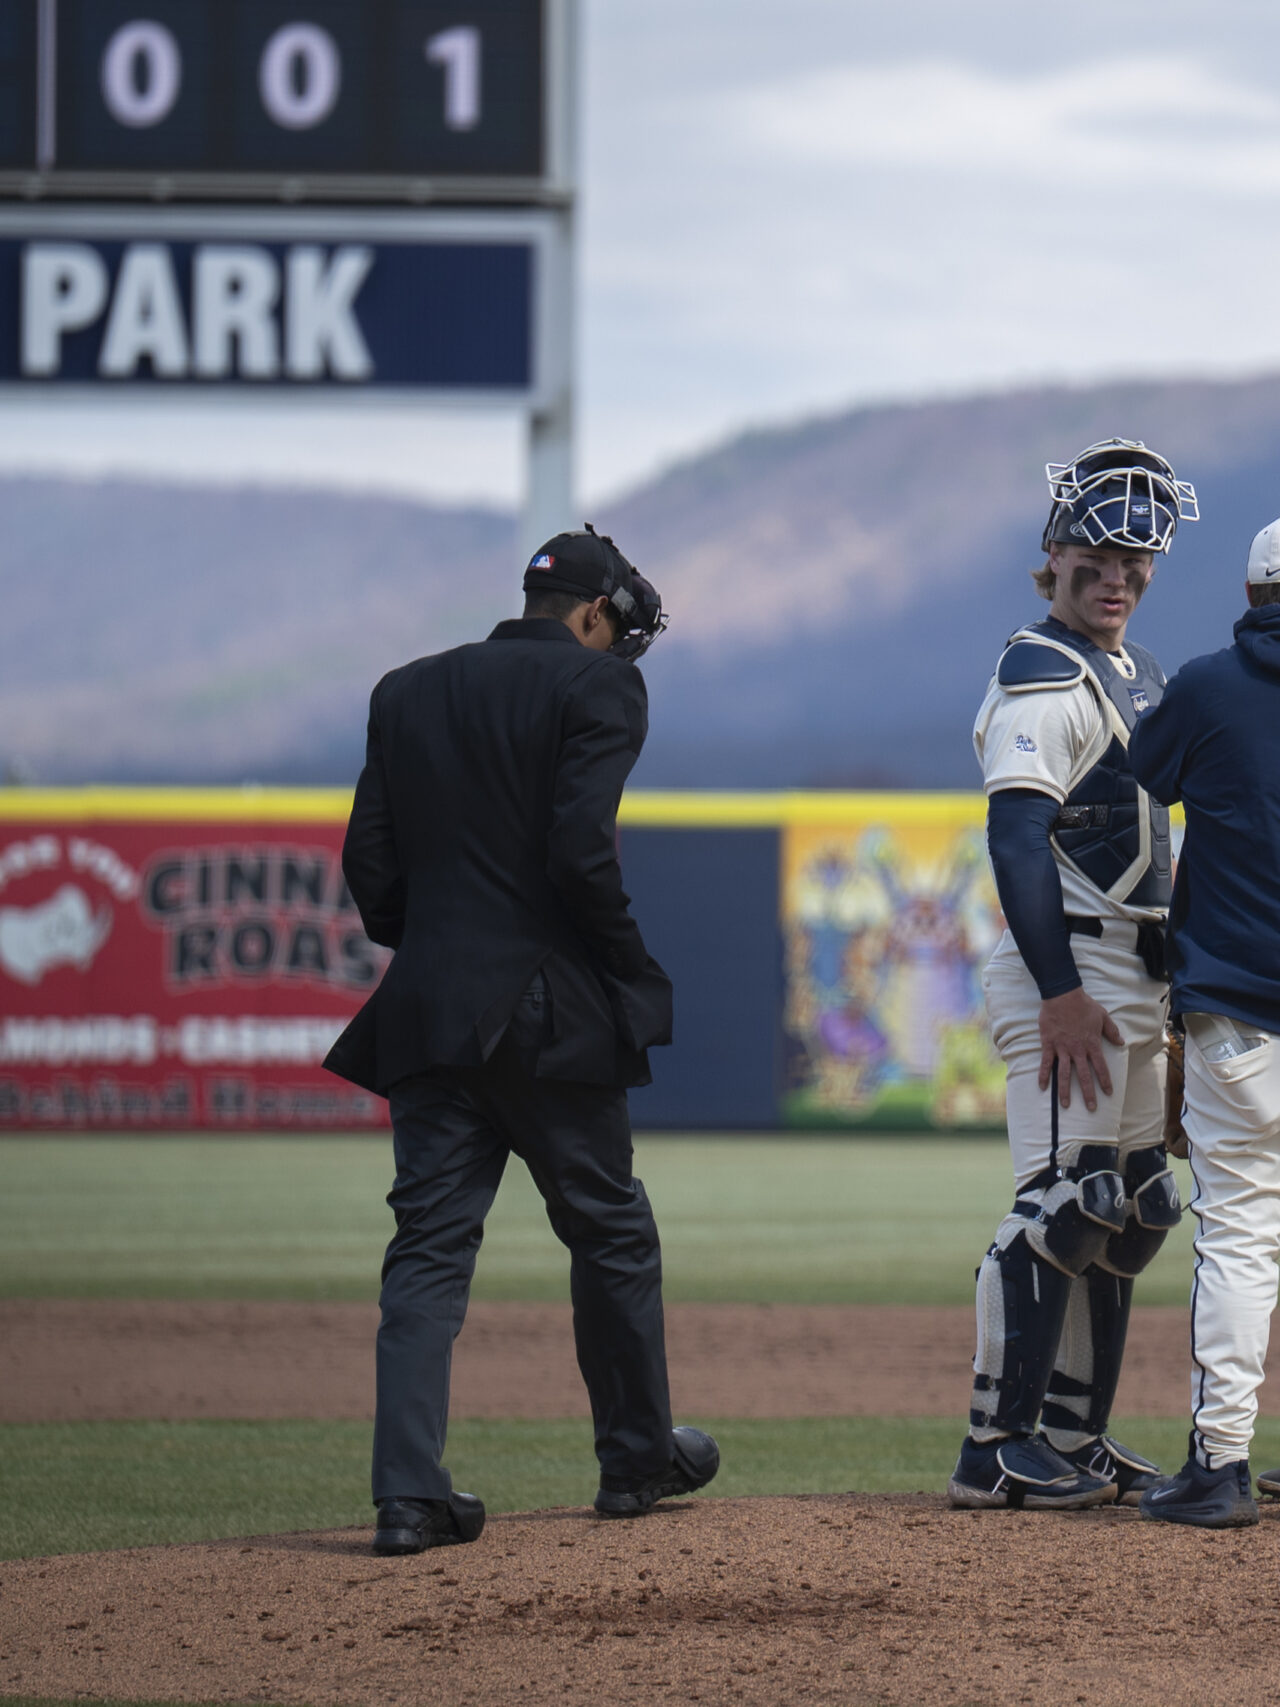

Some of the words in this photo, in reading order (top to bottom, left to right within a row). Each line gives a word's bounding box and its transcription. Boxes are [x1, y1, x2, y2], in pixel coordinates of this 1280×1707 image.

[102, 19, 182, 128] 0
[259, 22, 340, 130] 0
[425, 26, 480, 131] 1
[20, 241, 374, 379] PARK
[0, 835, 60, 888] OR
